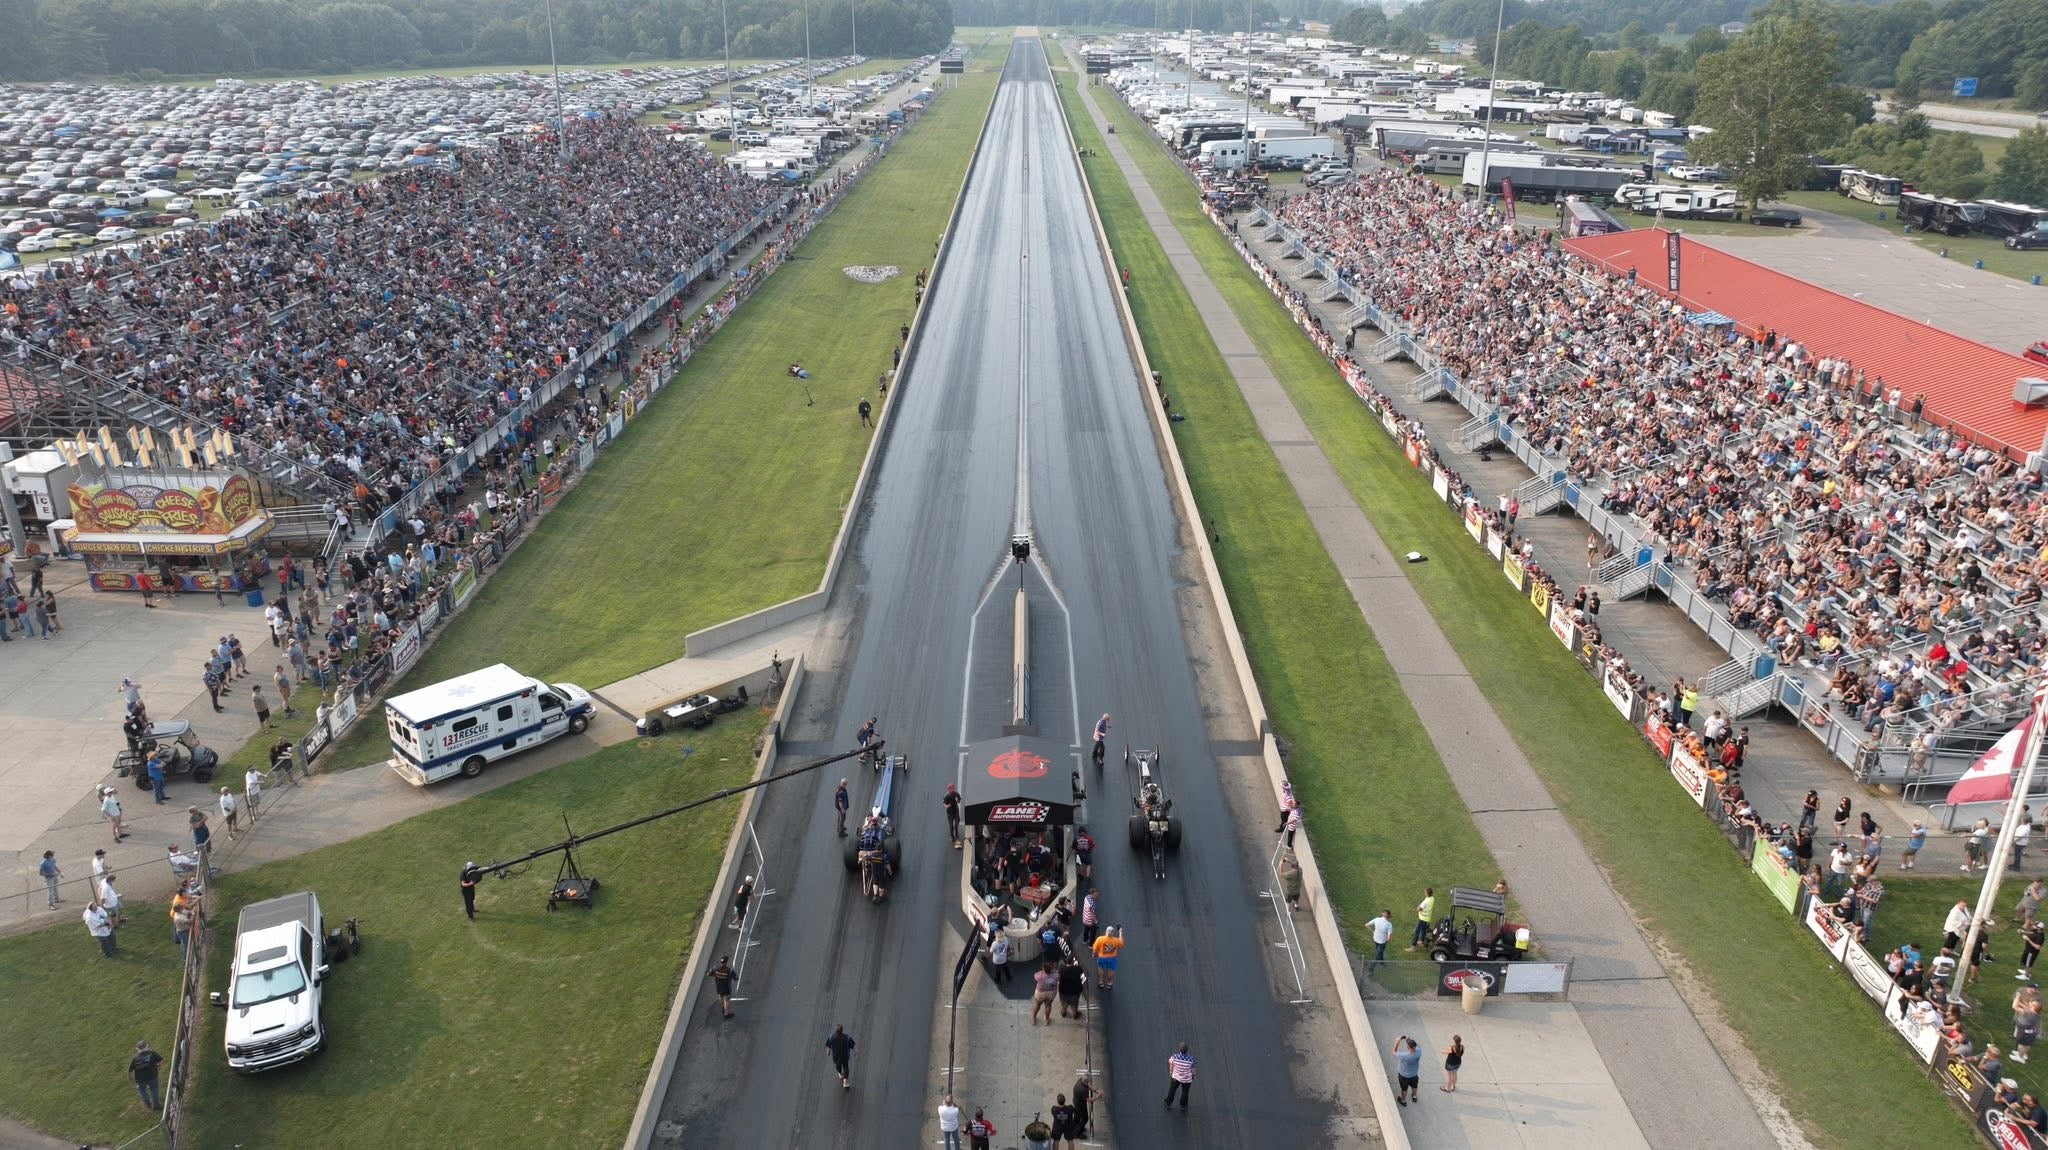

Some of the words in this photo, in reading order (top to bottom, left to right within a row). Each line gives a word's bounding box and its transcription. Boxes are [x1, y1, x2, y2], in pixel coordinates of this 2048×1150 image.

[155, 495, 195, 509] CHEESE
[98, 507, 139, 524] SAUSAGE
[161, 510, 199, 525] FRIES
[443, 732, 459, 747] 131
[459, 722, 489, 740] RESCUE
[446, 743, 464, 751] TRACK
[465, 734, 489, 745] SERVICES
[995, 807, 1037, 815] LANE
[1999, 1122, 2016, 1141] RED
